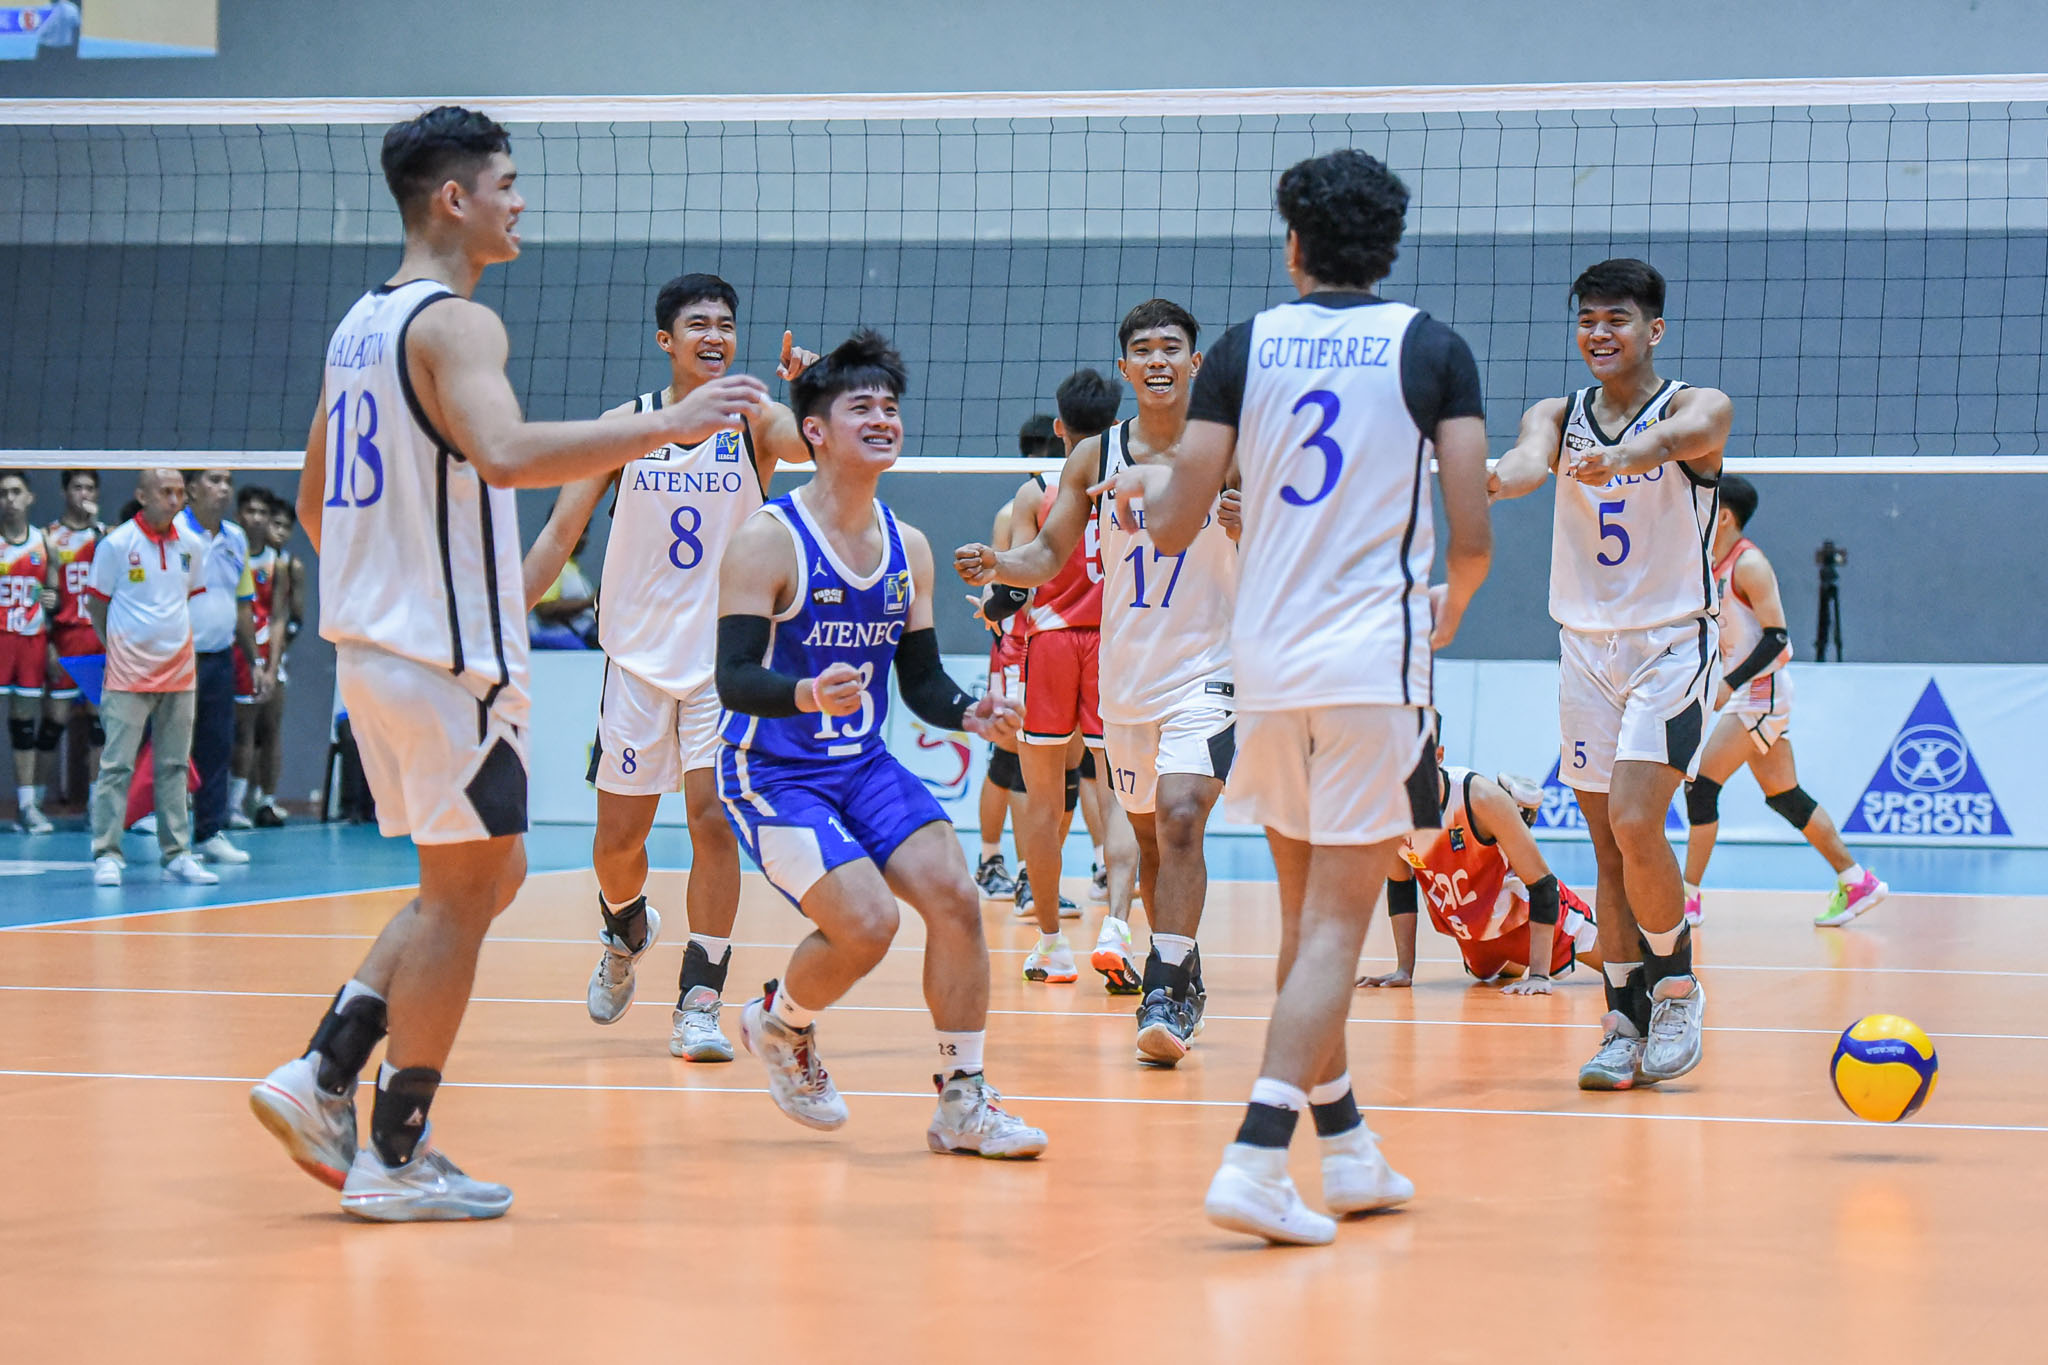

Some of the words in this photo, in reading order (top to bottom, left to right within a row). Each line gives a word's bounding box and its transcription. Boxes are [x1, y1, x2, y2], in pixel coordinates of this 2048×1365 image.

[1258, 336, 1392, 370] GUTIERREZ
[325, 389, 384, 508] 18
[717, 453, 737, 461] LEAGUE
[1279, 389, 1344, 507] 3
[632, 470, 742, 493] ATENEO
[668, 505, 704, 570] 8
[1596, 499, 1631, 567] 5
[1124, 545, 1188, 608] 17
[802, 620, 906, 648] ATENEO
[621, 747, 638, 775] 8
[1572, 740, 1588, 769] 5
[1115, 767, 1136, 795] 17
[1862, 791, 1995, 816] SPORTS
[1863, 813, 1994, 835] VISION
